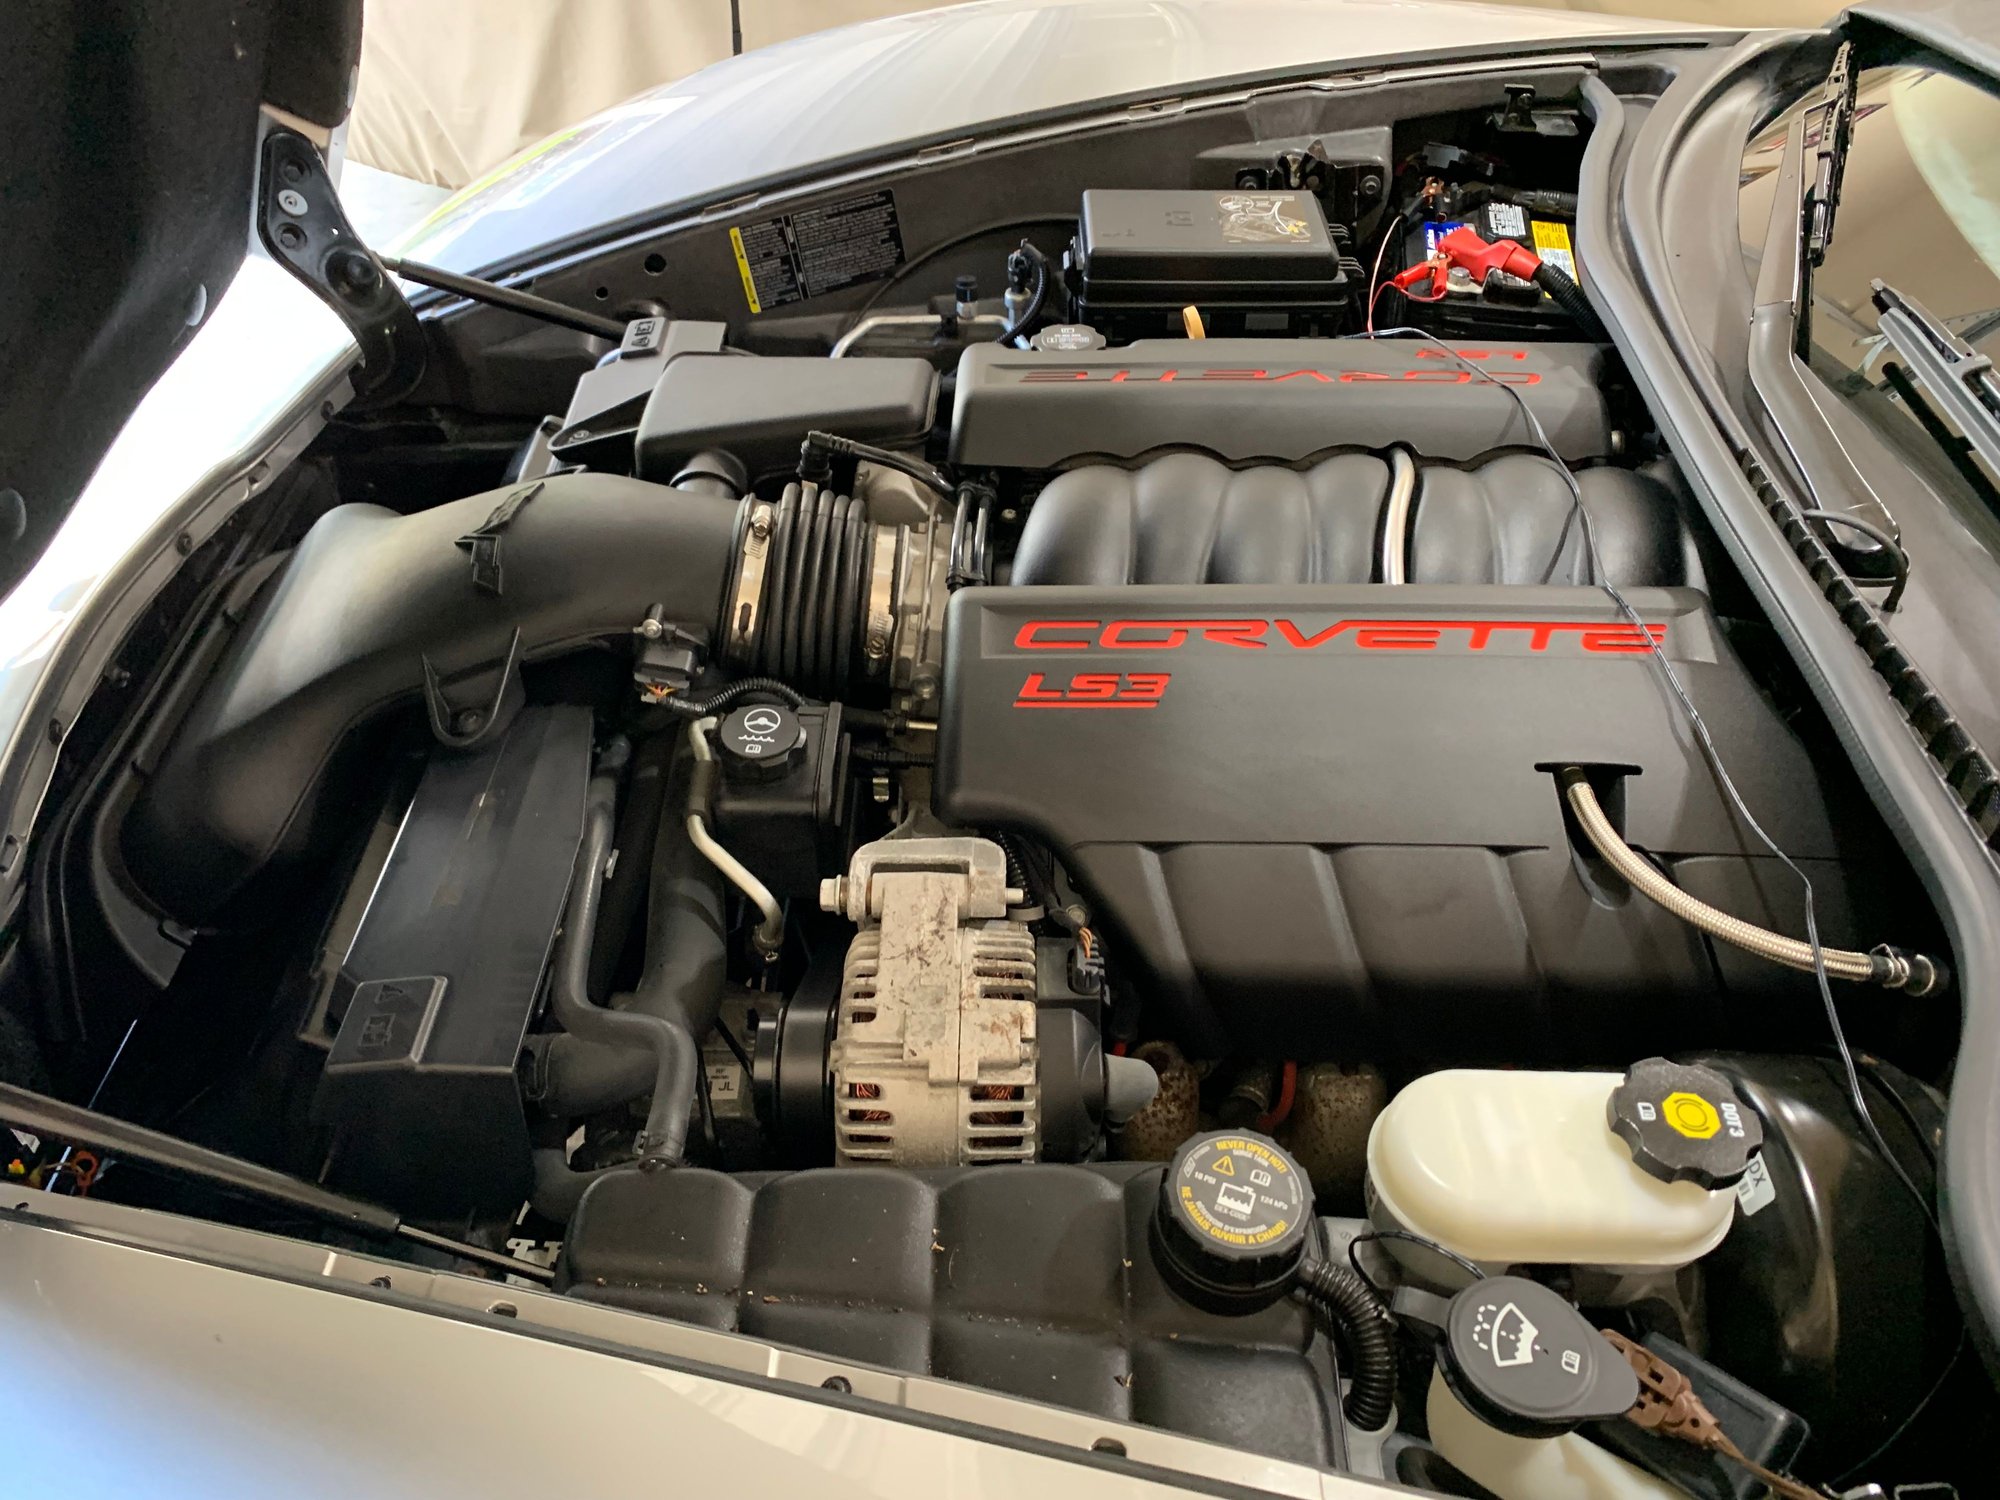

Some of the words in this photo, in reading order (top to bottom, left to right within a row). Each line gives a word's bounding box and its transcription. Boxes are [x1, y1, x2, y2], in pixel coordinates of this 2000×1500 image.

[1013, 618, 1667, 654] CORVETTE
[1018, 673, 1172, 699] LS3
[1721, 1103, 1743, 1128] DOT
[1729, 1126, 1745, 1138] 3
[1216, 1140, 1246, 1151] NEVER
[1246, 1142, 1271, 1160] OPEN
[1268, 1154, 1288, 1174] HOT!
[1181, 1186, 1193, 1199] NE
[1273, 1199, 1288, 1211] kPa
[1184, 1199, 1212, 1231] JAMAIS
[1210, 1226, 1247, 1244] OUVRIR
[1255, 1219, 1289, 1244] CHAUD!
